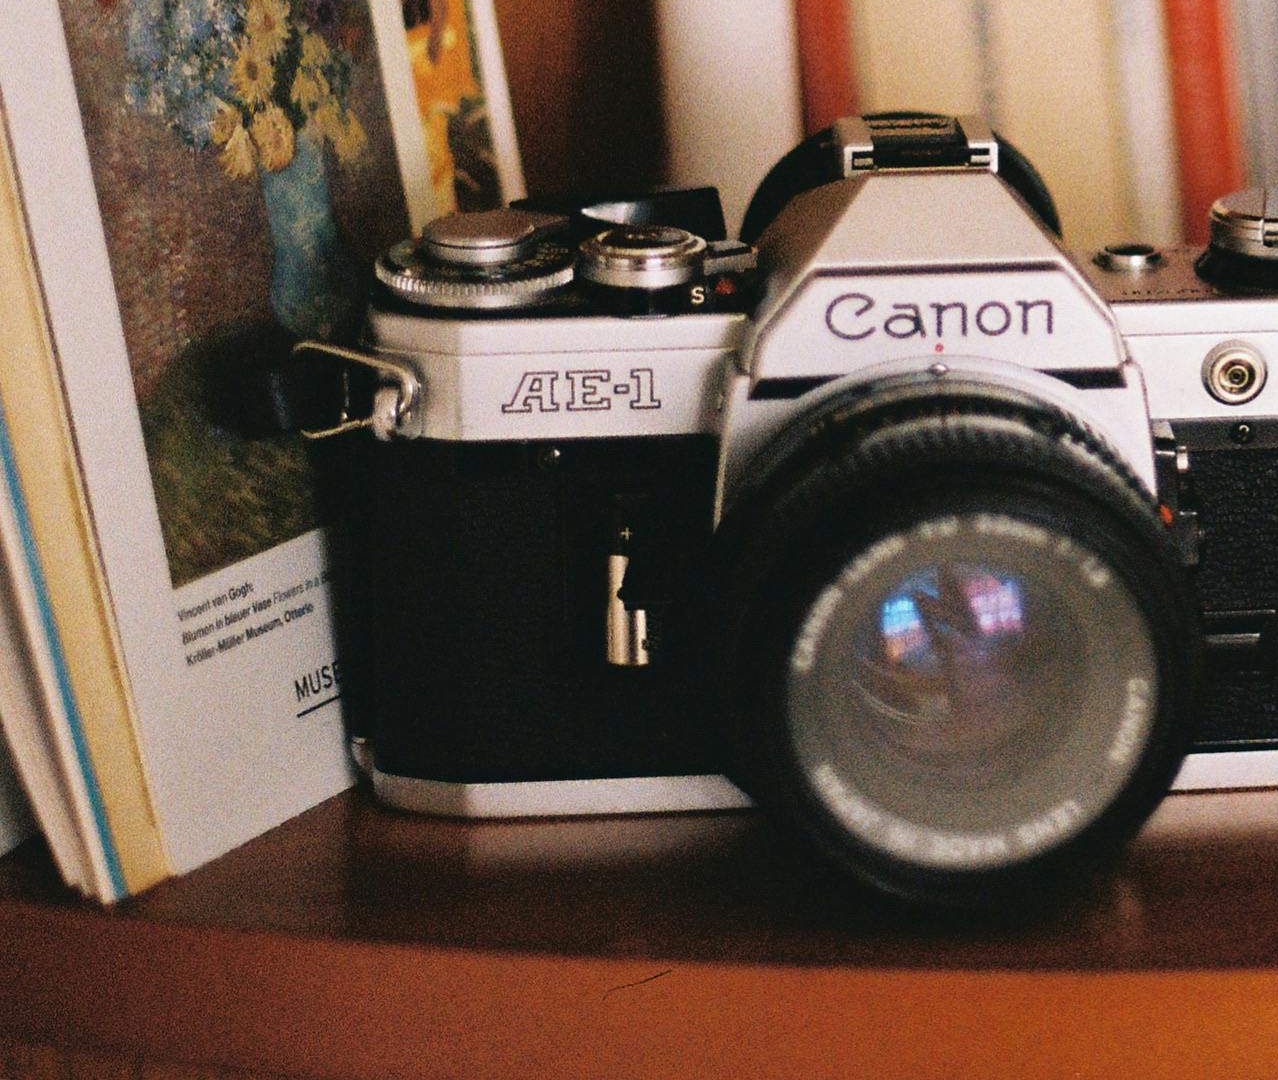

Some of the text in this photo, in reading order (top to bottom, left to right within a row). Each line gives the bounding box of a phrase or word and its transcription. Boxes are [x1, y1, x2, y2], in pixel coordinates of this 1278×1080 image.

[690, 286, 706, 306] S
[824, 291, 1054, 340] Canon
[500, 367, 662, 413] AE-1
[211, 594, 229, 609] van
